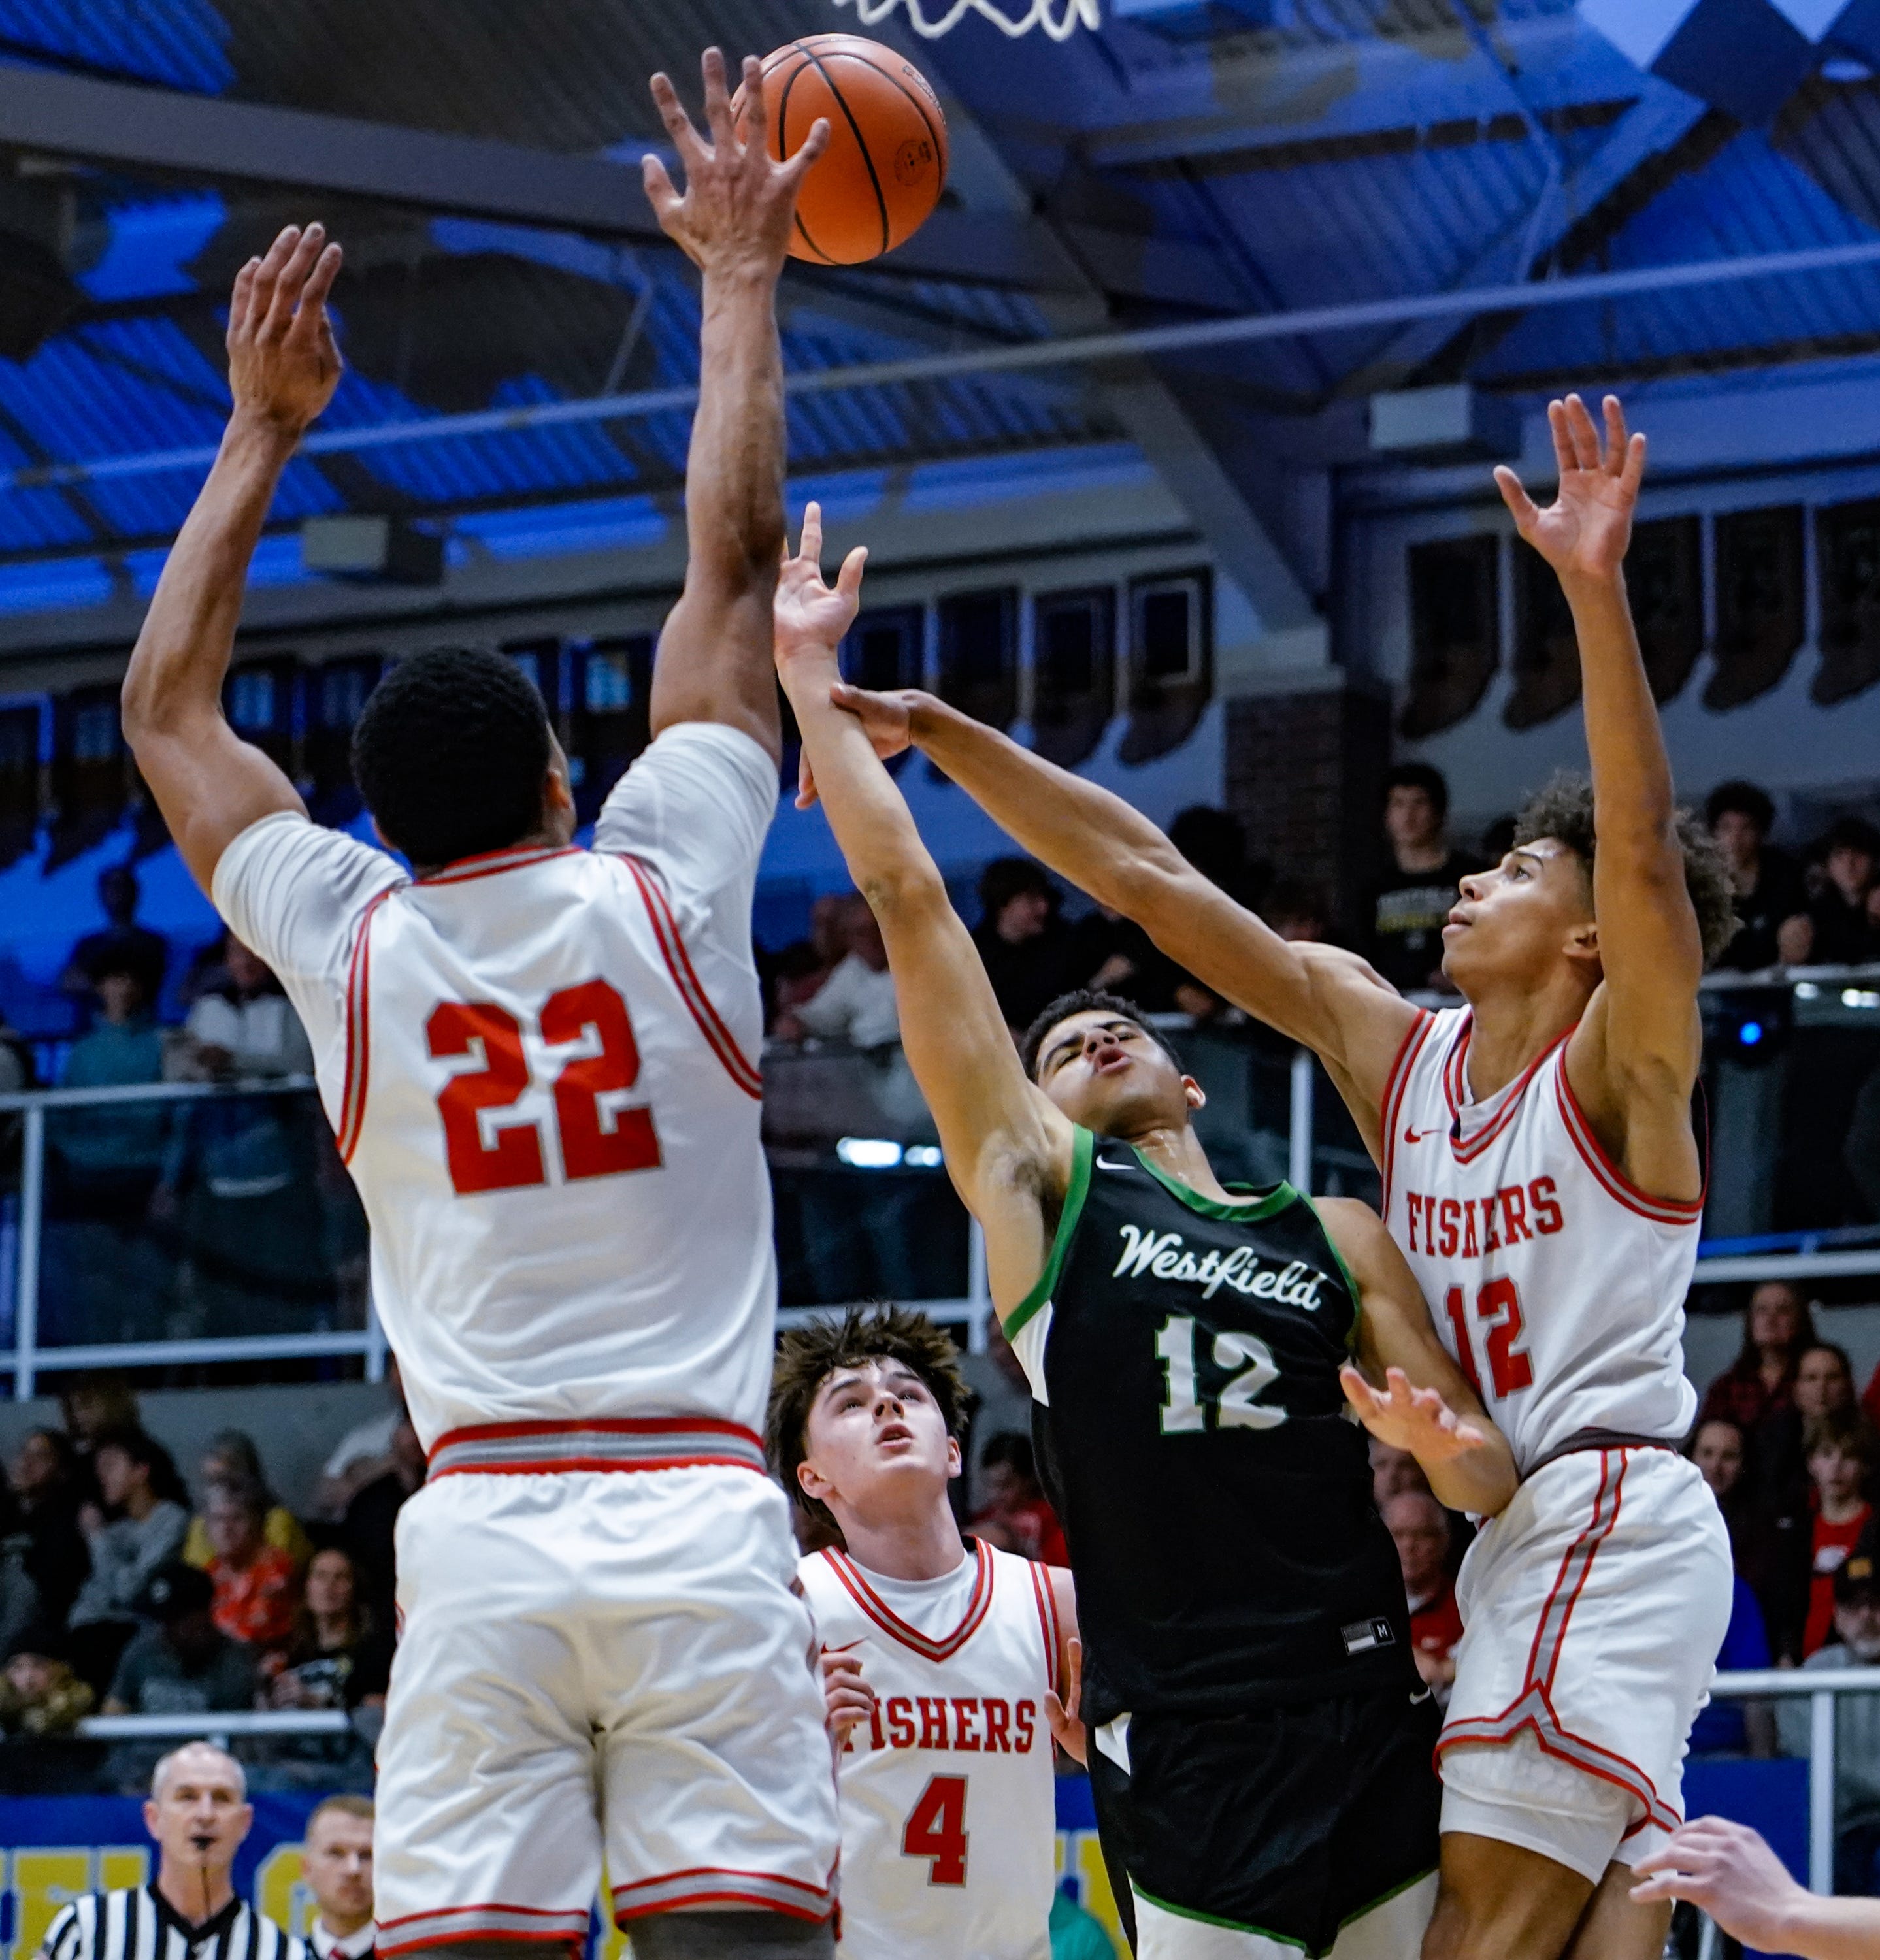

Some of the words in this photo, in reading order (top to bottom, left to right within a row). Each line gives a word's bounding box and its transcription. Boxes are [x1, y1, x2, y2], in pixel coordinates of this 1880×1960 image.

[423, 974, 664, 1198] 22
[1113, 1224, 1328, 1311] Westfield
[1155, 1315, 1289, 1435] 12
[1443, 1272, 1534, 1403] 12
[1376, 1624, 1389, 1638] M
[842, 1697, 1036, 1754] ISHERS
[901, 1772, 969, 1888] 4
